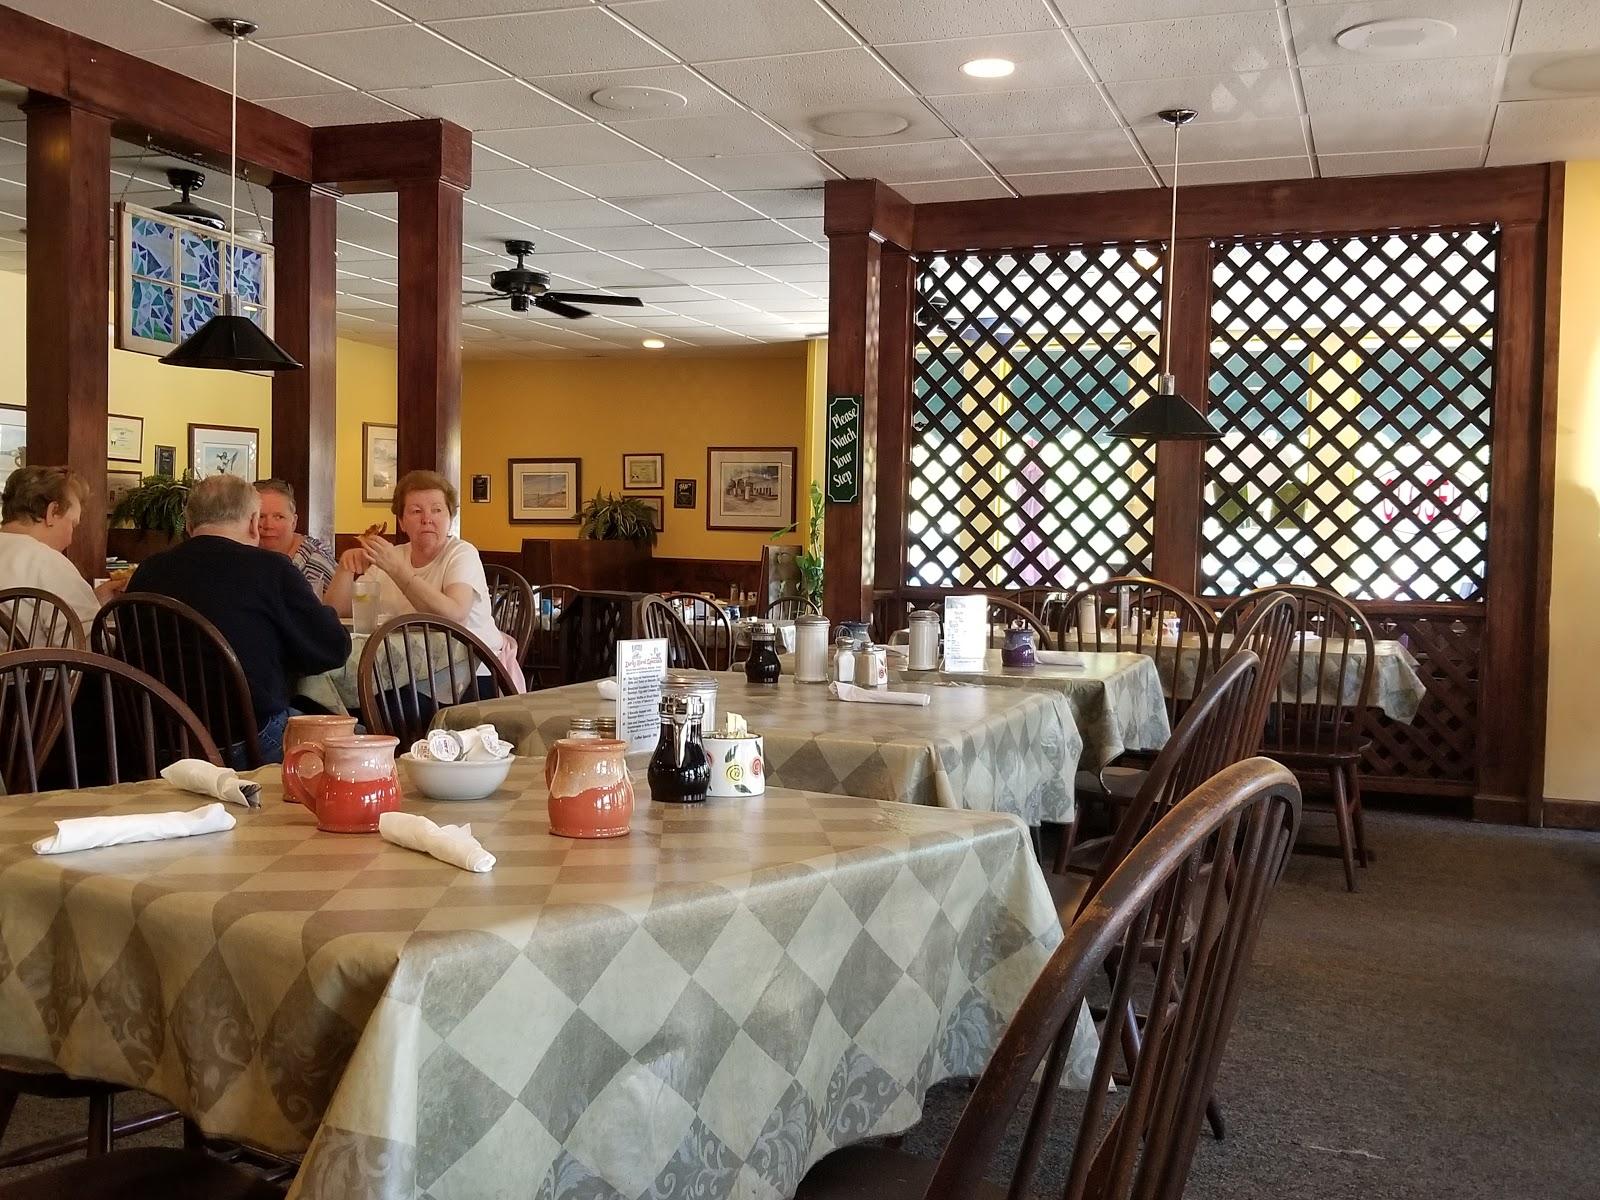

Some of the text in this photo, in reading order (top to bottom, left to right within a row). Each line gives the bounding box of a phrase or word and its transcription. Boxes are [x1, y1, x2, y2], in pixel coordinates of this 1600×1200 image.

[832, 408, 857, 429] Please
[831, 427, 856, 450] Watch
[832, 451, 852, 469] Your
[833, 470, 852, 488] Step
